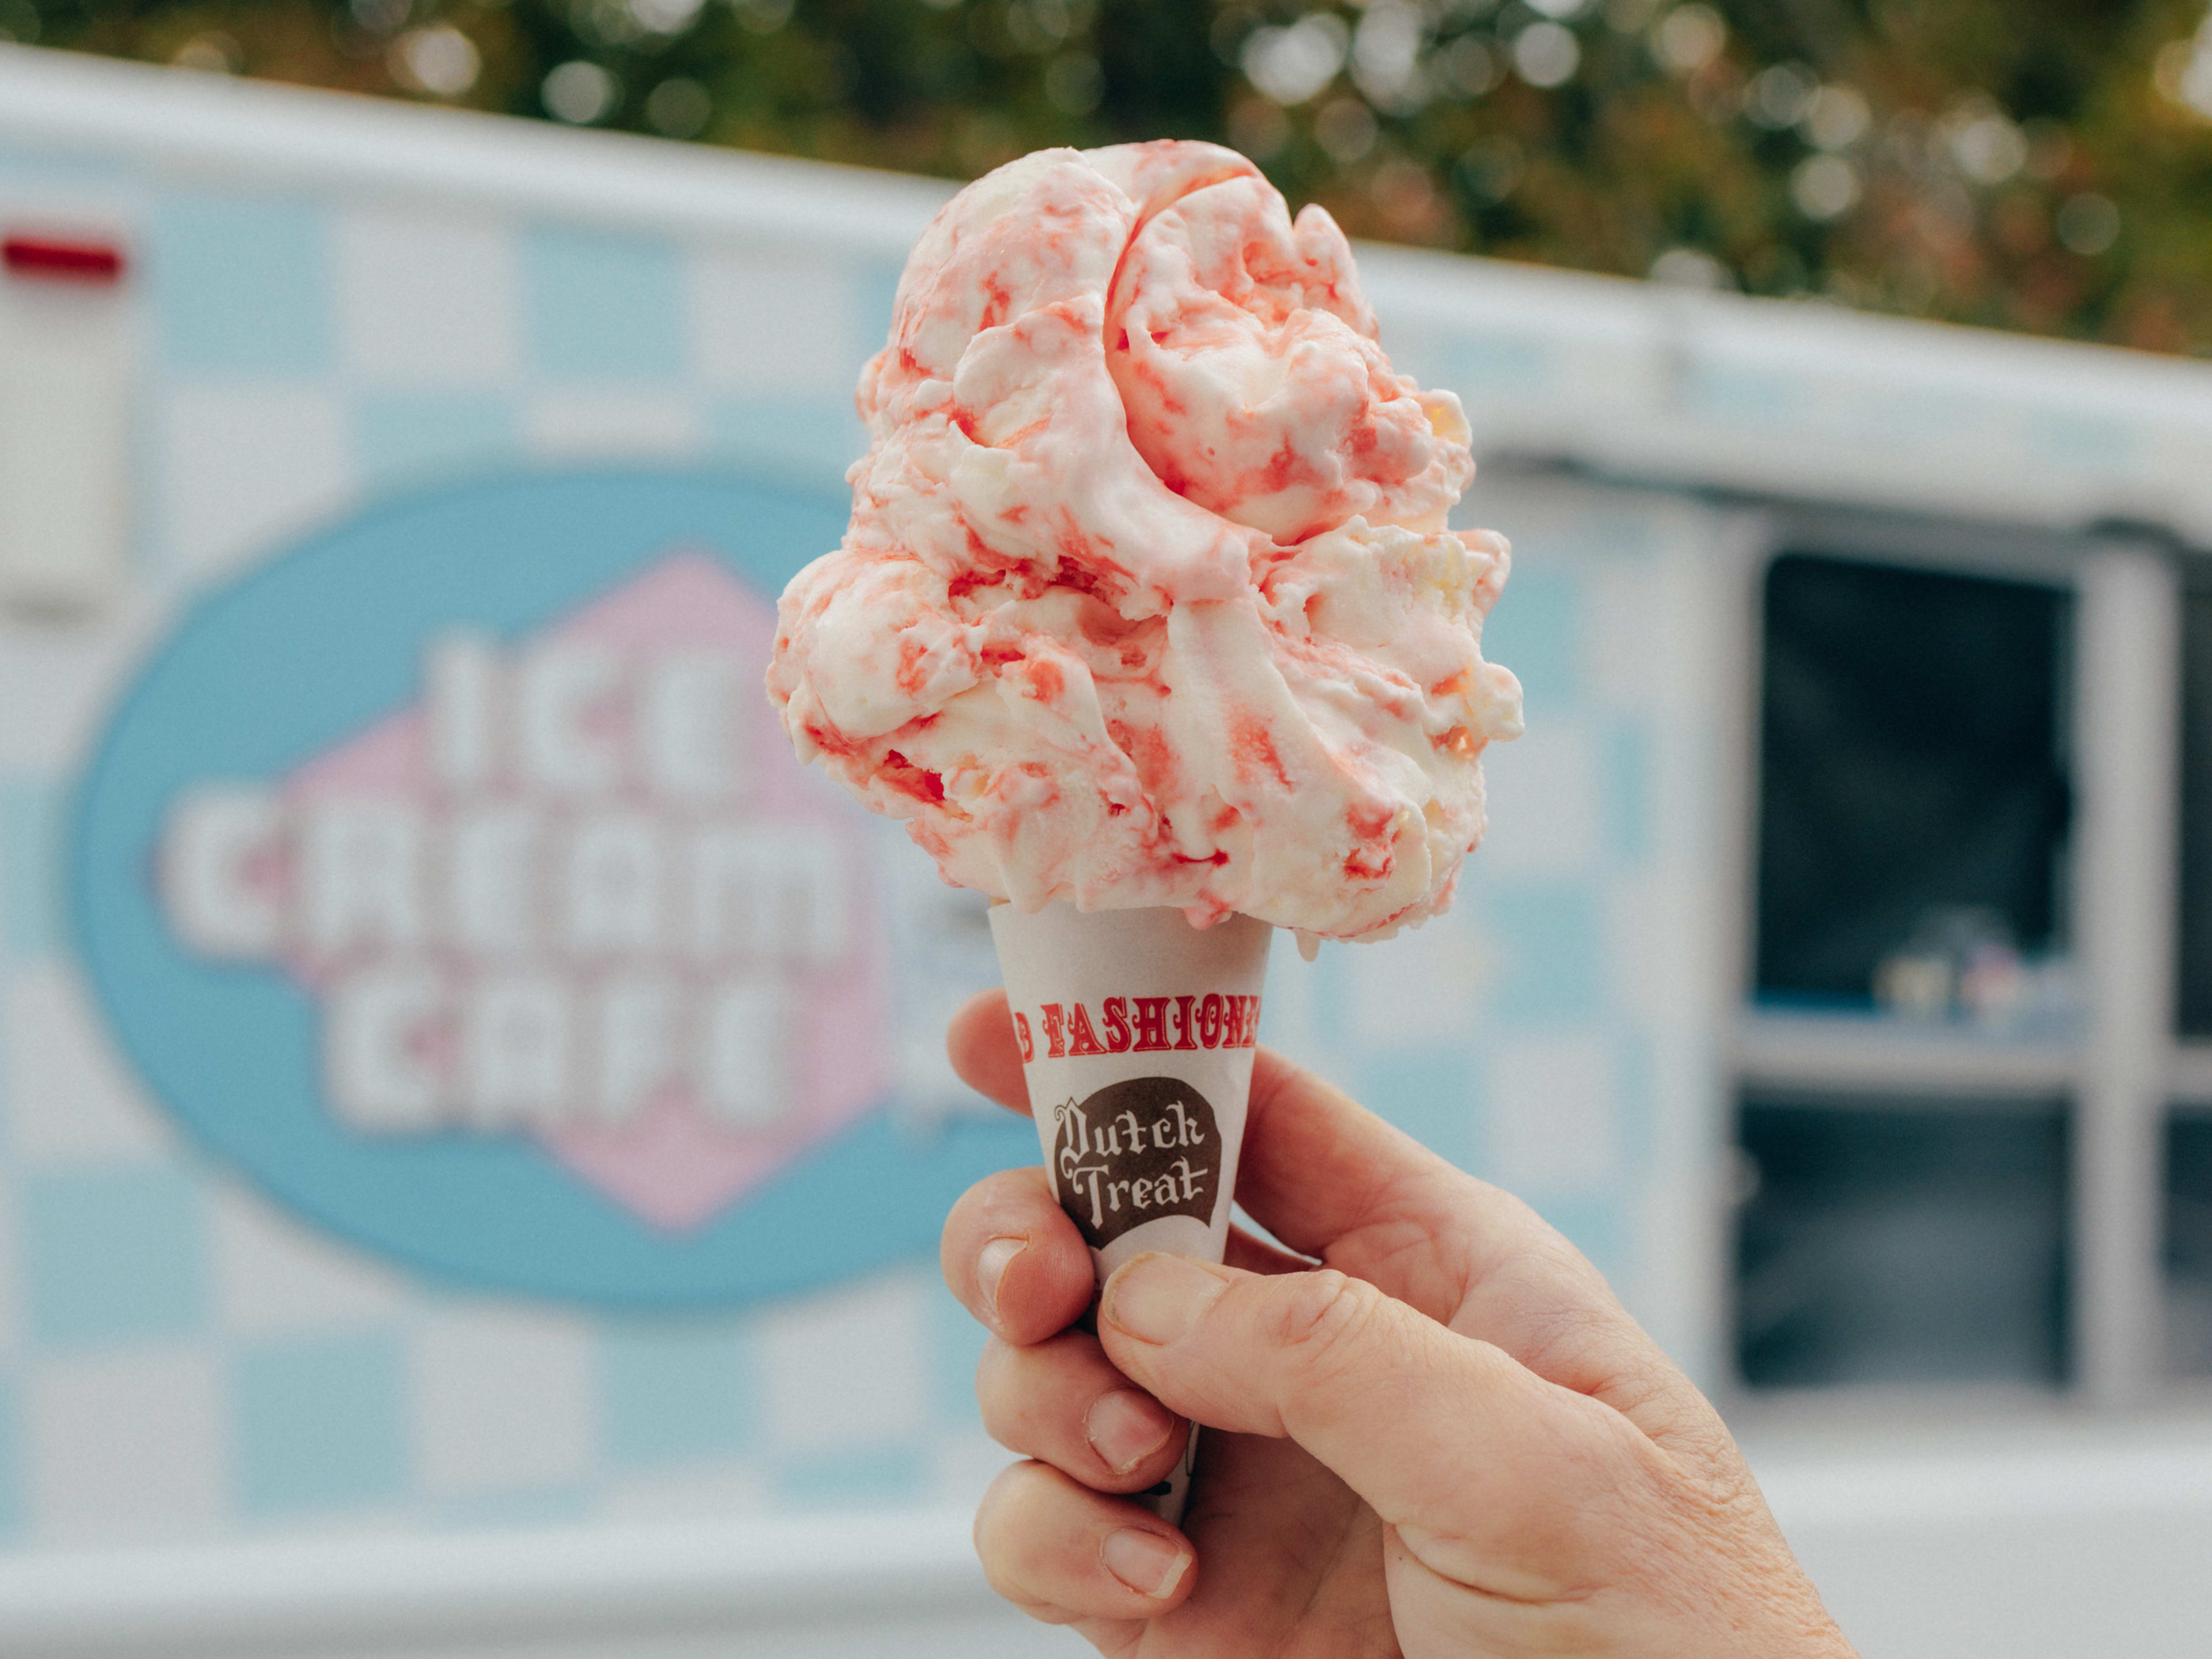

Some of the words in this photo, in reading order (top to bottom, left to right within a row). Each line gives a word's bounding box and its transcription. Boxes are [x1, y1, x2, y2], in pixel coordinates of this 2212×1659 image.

[423, 627, 763, 801] ICE
[329, 971, 795, 1129] CAFE
[1055, 1097, 1205, 1179] Dutch
[1072, 1156, 1208, 1229] Treat
